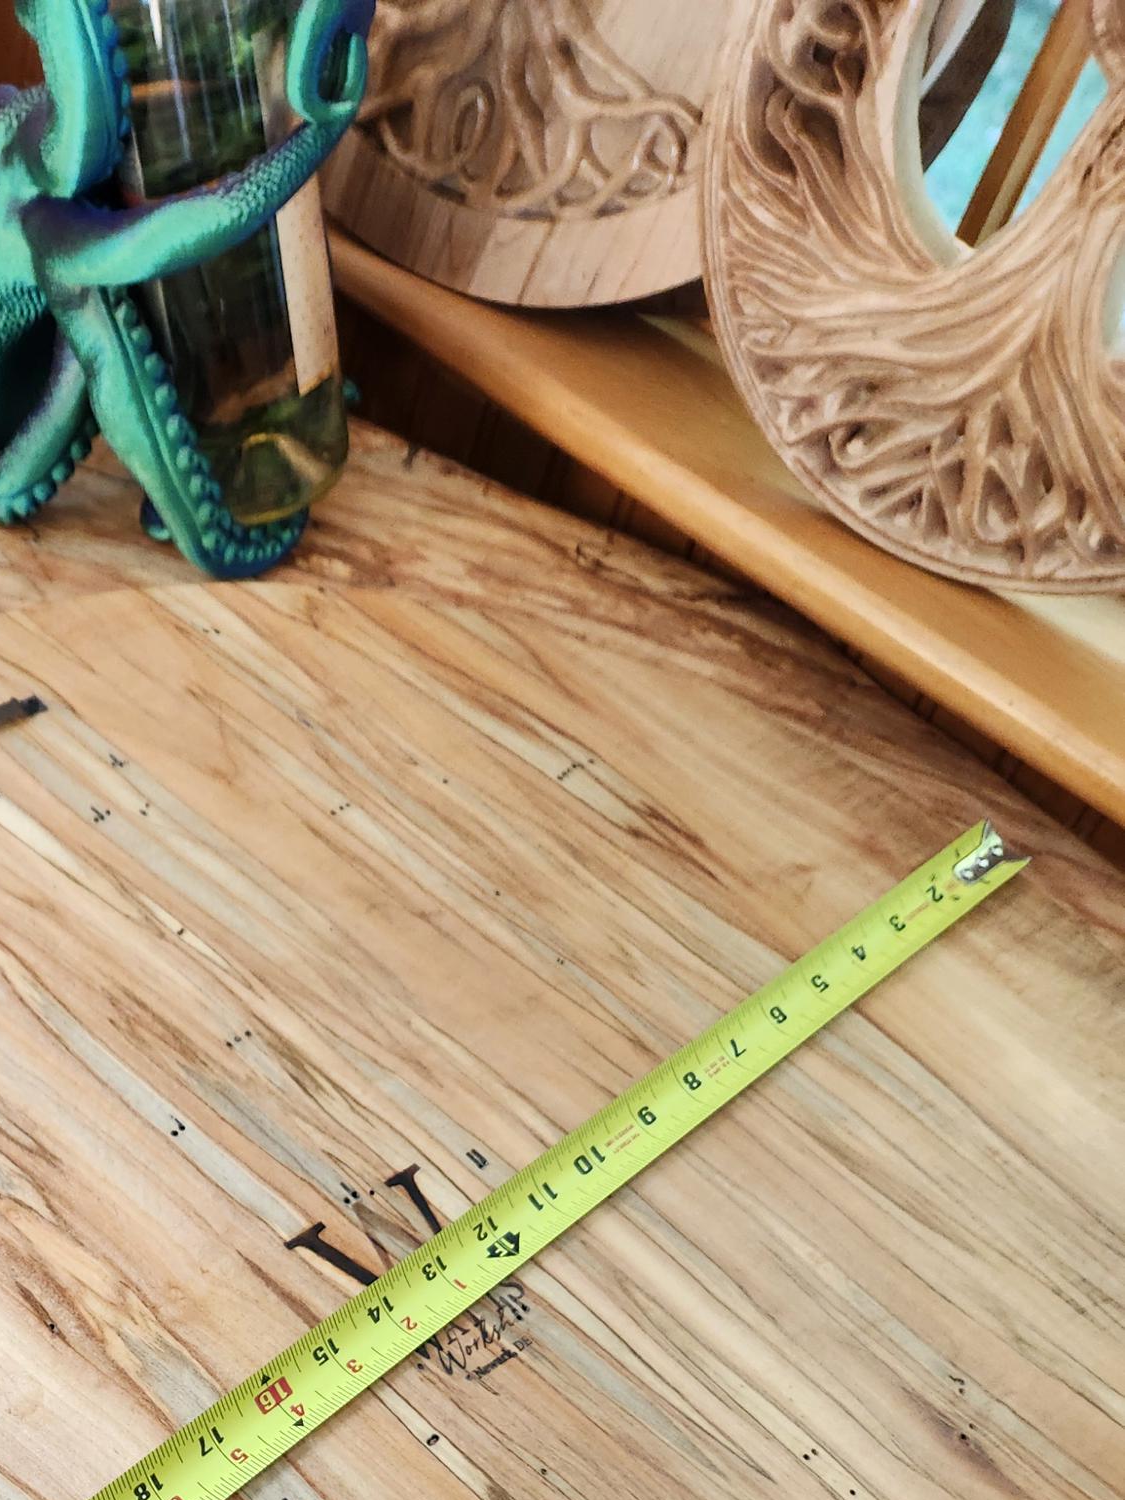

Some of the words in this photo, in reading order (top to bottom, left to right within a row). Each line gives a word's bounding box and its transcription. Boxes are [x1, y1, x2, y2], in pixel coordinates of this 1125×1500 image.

[926, 886, 944, 903] 2
[889, 914, 906, 932] 3
[851, 944, 866, 961] 4
[811, 975, 829, 994] 5
[769, 1006, 787, 1024] 6
[729, 1039, 746, 1057] 7
[682, 1071, 701, 1090] 8
[637, 1106, 656, 1126] 9
[574, 1145, 606, 1175] 10
[528, 1182, 558, 1211] 11
[473, 1215, 499, 1241] 12
[422, 1255, 448, 1281] 13
[454, 1279, 467, 1290] 1
[366, 1296, 394, 1323] 14
[400, 1316, 418, 1331] 2
[312, 1338, 339, 1366] 15
[513, 1336, 533, 1352] DE
[346, 1358, 363, 1373] 3
[260, 1381, 291, 1410] 16
[290, 1402, 305, 1418] 4
[198, 1426, 224, 1457] 17
[230, 1448, 249, 1463] 5
